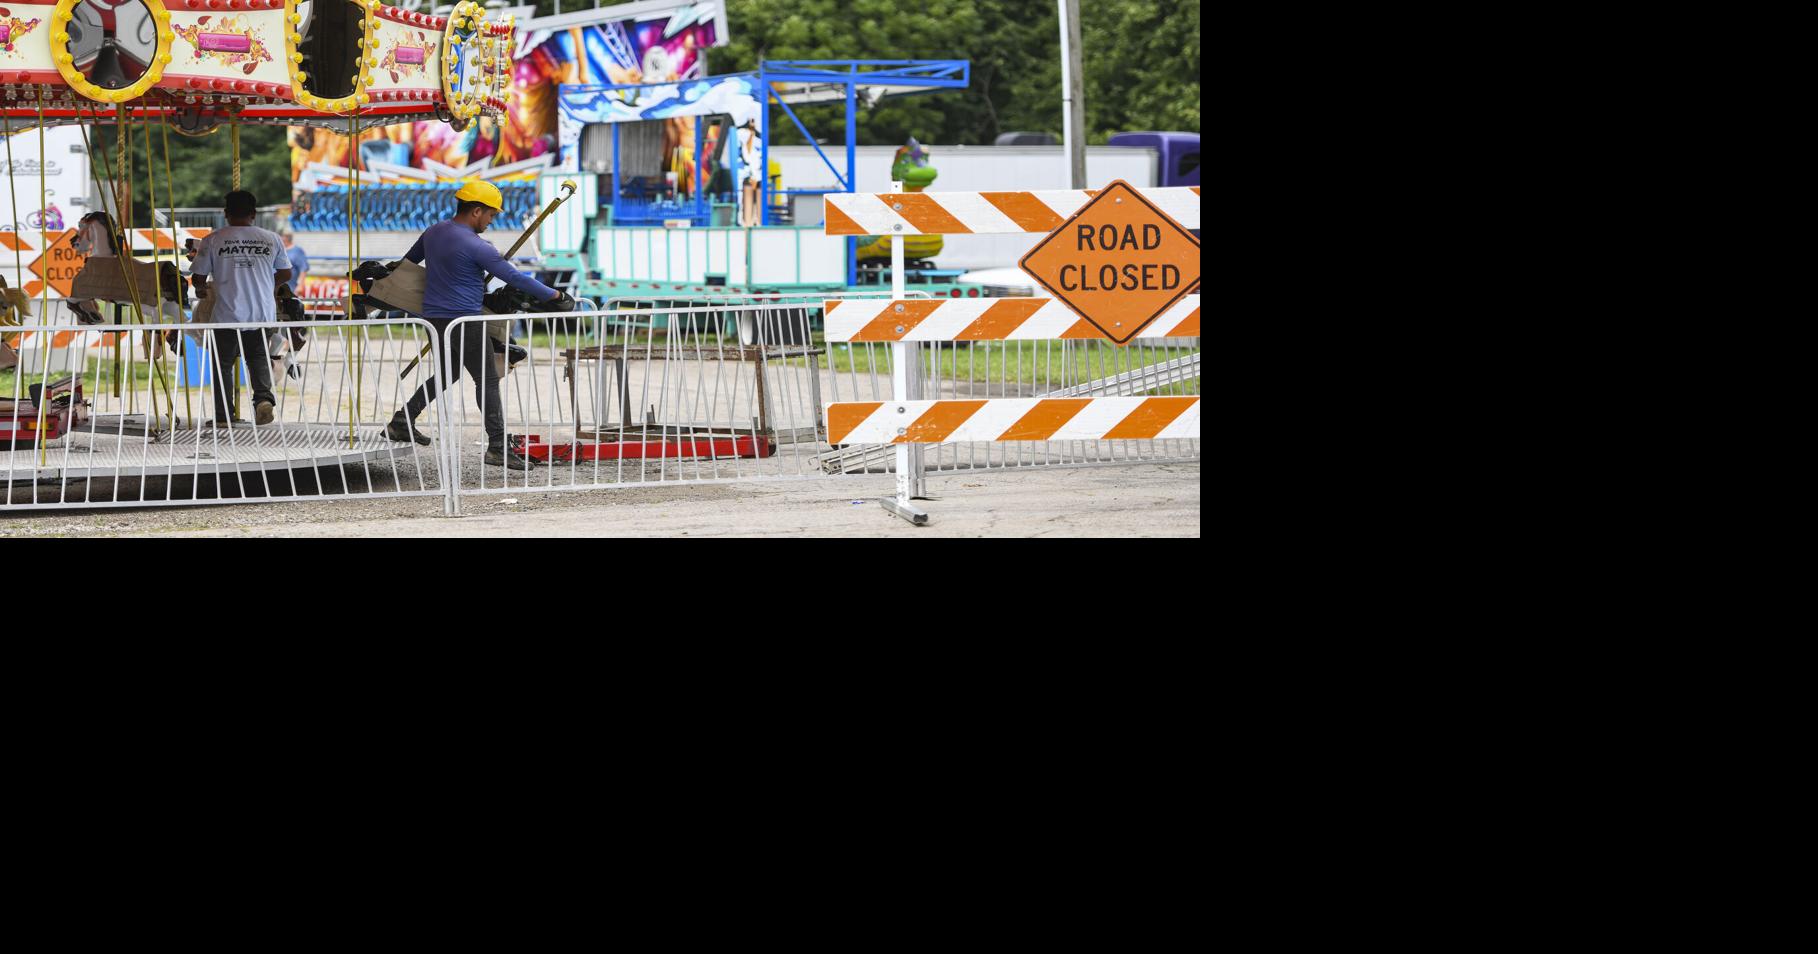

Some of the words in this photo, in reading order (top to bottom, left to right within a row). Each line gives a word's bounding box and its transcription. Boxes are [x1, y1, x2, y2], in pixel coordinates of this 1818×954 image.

[1077, 223, 1161, 251] ROAD
[54, 247, 84, 261] ROA
[218, 246, 270, 256] MATTER
[1059, 263, 1181, 292] CLOSED
